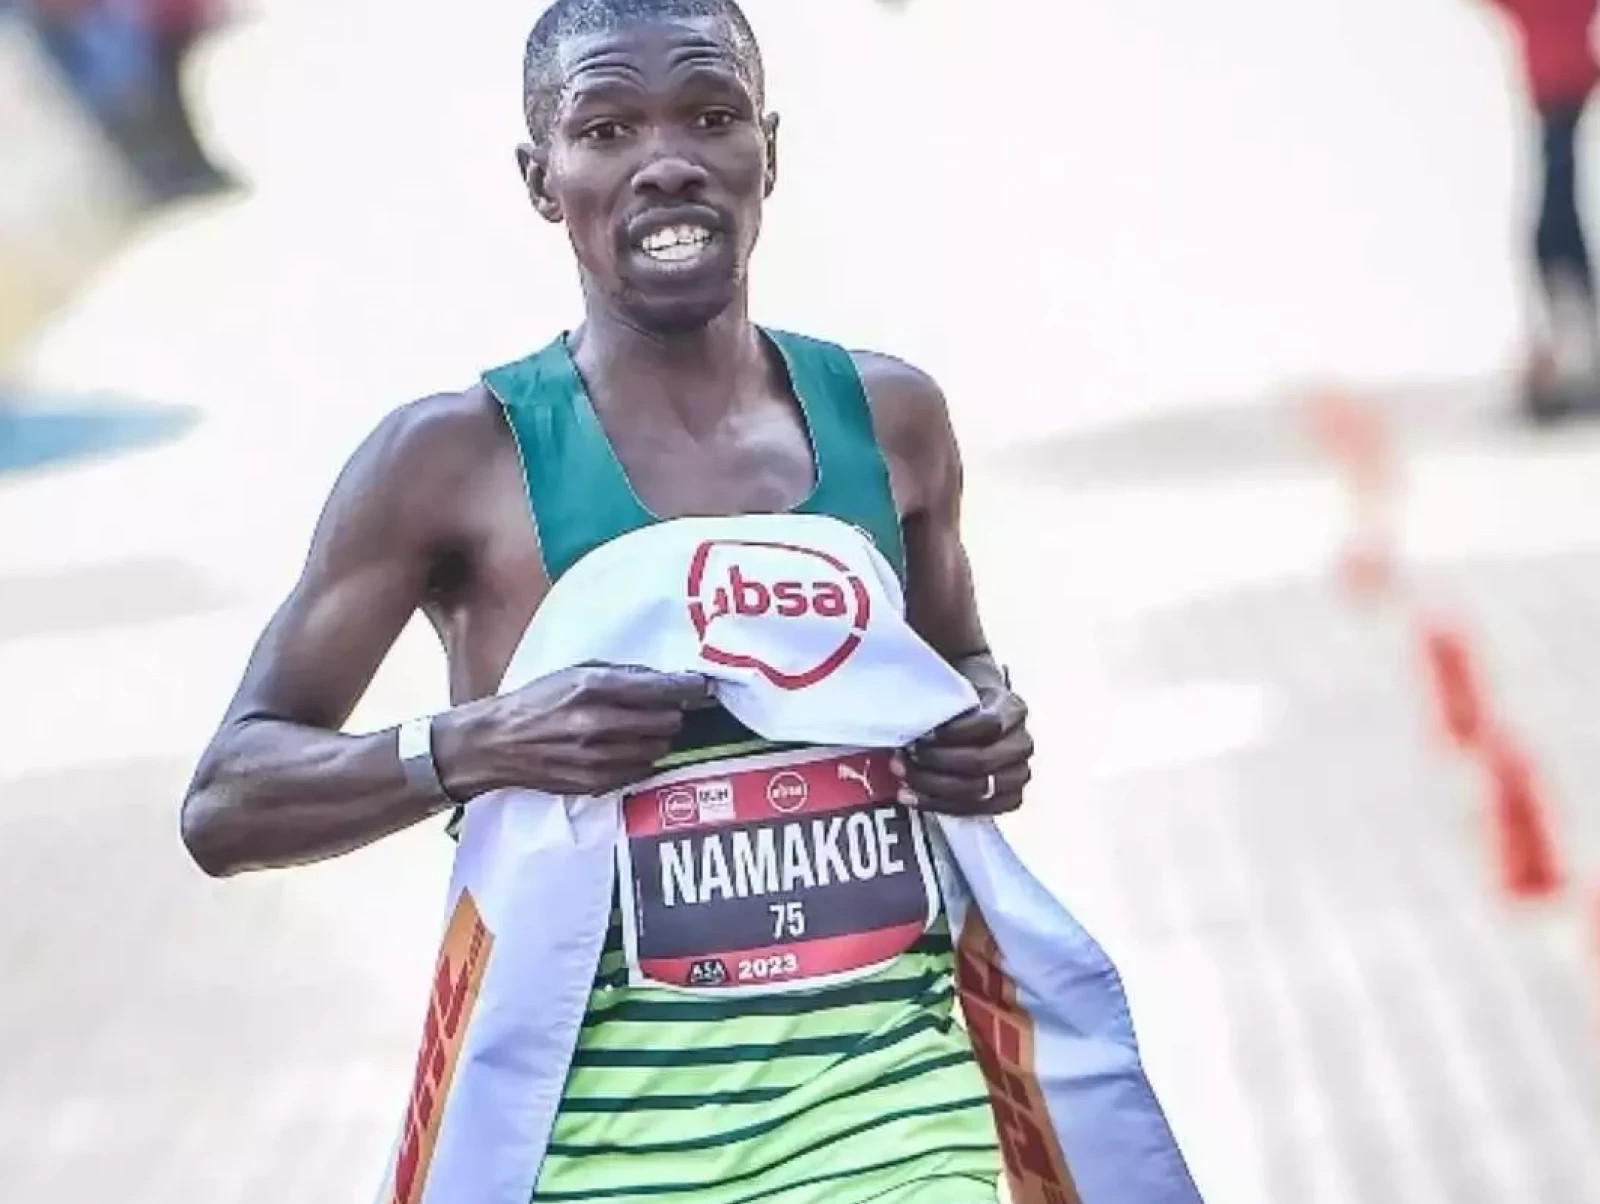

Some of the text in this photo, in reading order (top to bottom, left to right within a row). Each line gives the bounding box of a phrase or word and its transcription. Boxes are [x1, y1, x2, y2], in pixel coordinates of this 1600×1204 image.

[659, 808, 905, 907] NAMAKOE
[769, 902, 805, 939] 75
[738, 953, 798, 981] 2023
